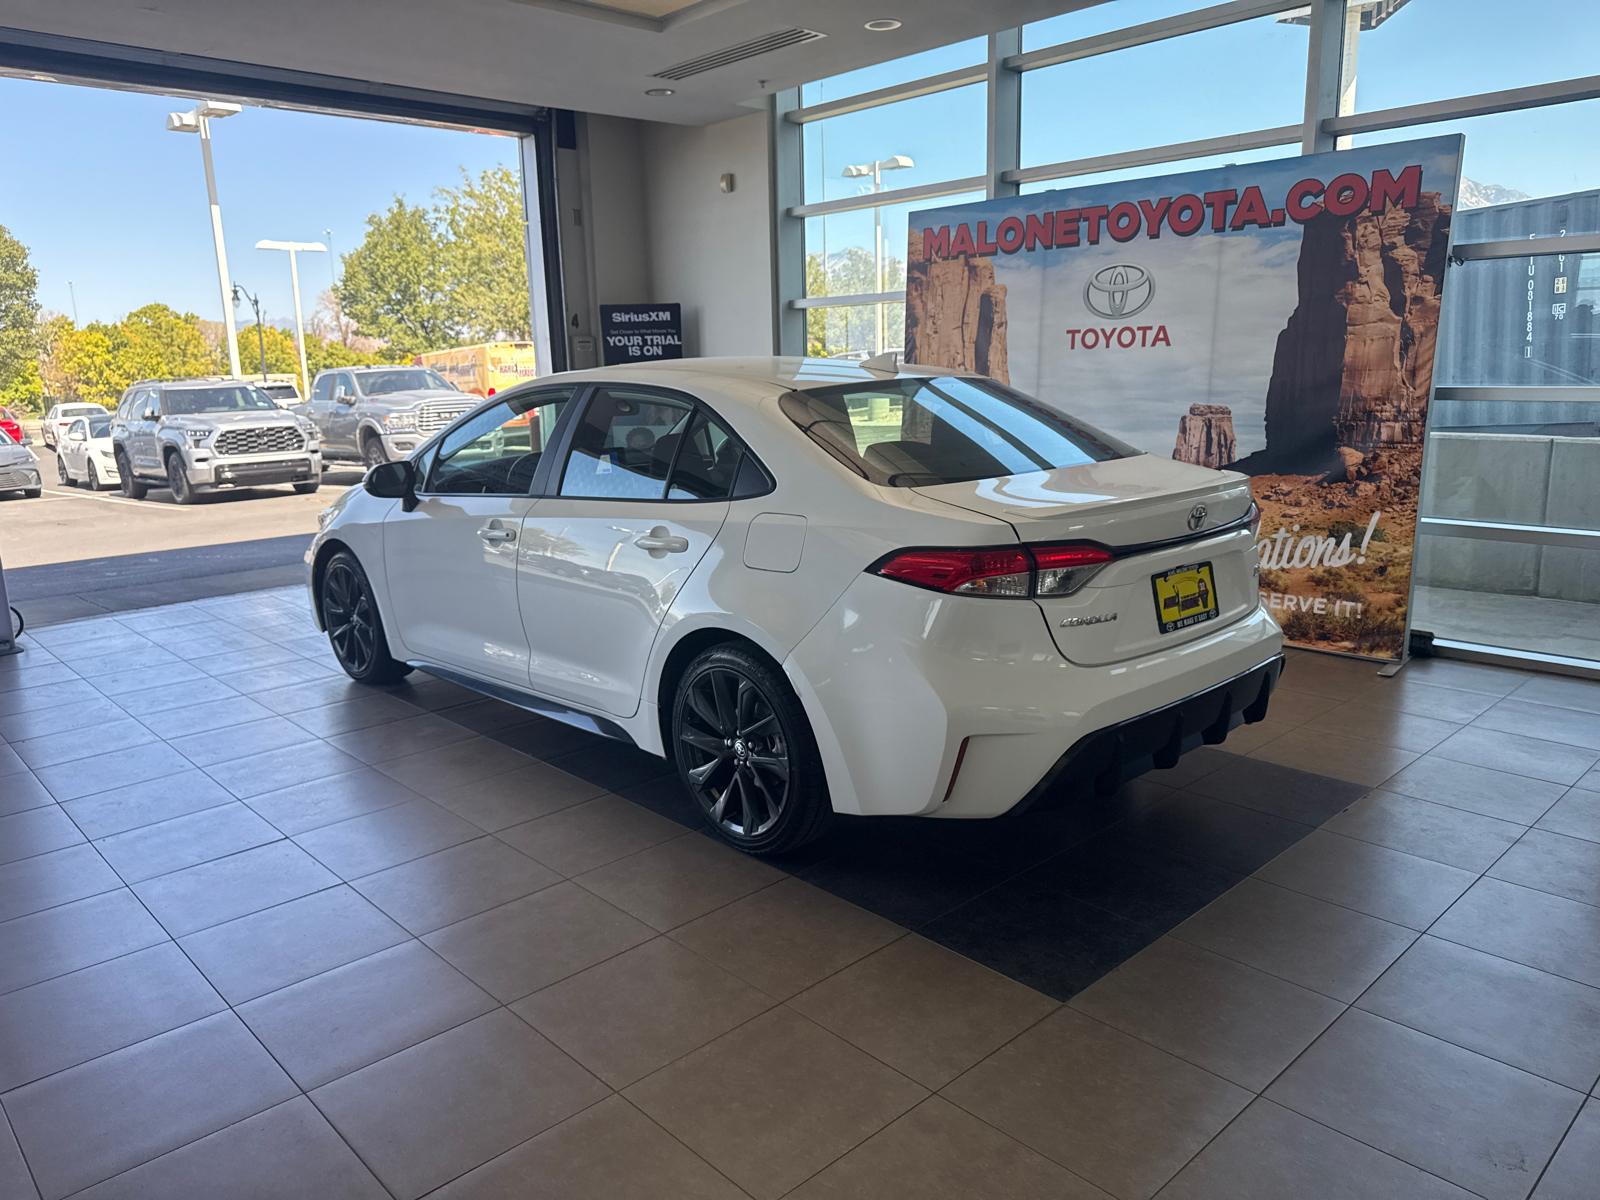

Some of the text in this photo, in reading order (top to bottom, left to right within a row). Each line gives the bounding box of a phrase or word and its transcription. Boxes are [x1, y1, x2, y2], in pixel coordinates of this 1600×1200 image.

[922, 164, 1423, 263] MALONETOYOTA.COM
[571, 313, 580, 329] 4
[612, 312, 670, 322] SiriusXM
[606, 335, 682, 346] YOUR TRIAL
[1066, 325, 1171, 350] TOYOTA
[628, 345, 663, 356] IS ON
[1334, 600, 1362, 619] IT!
